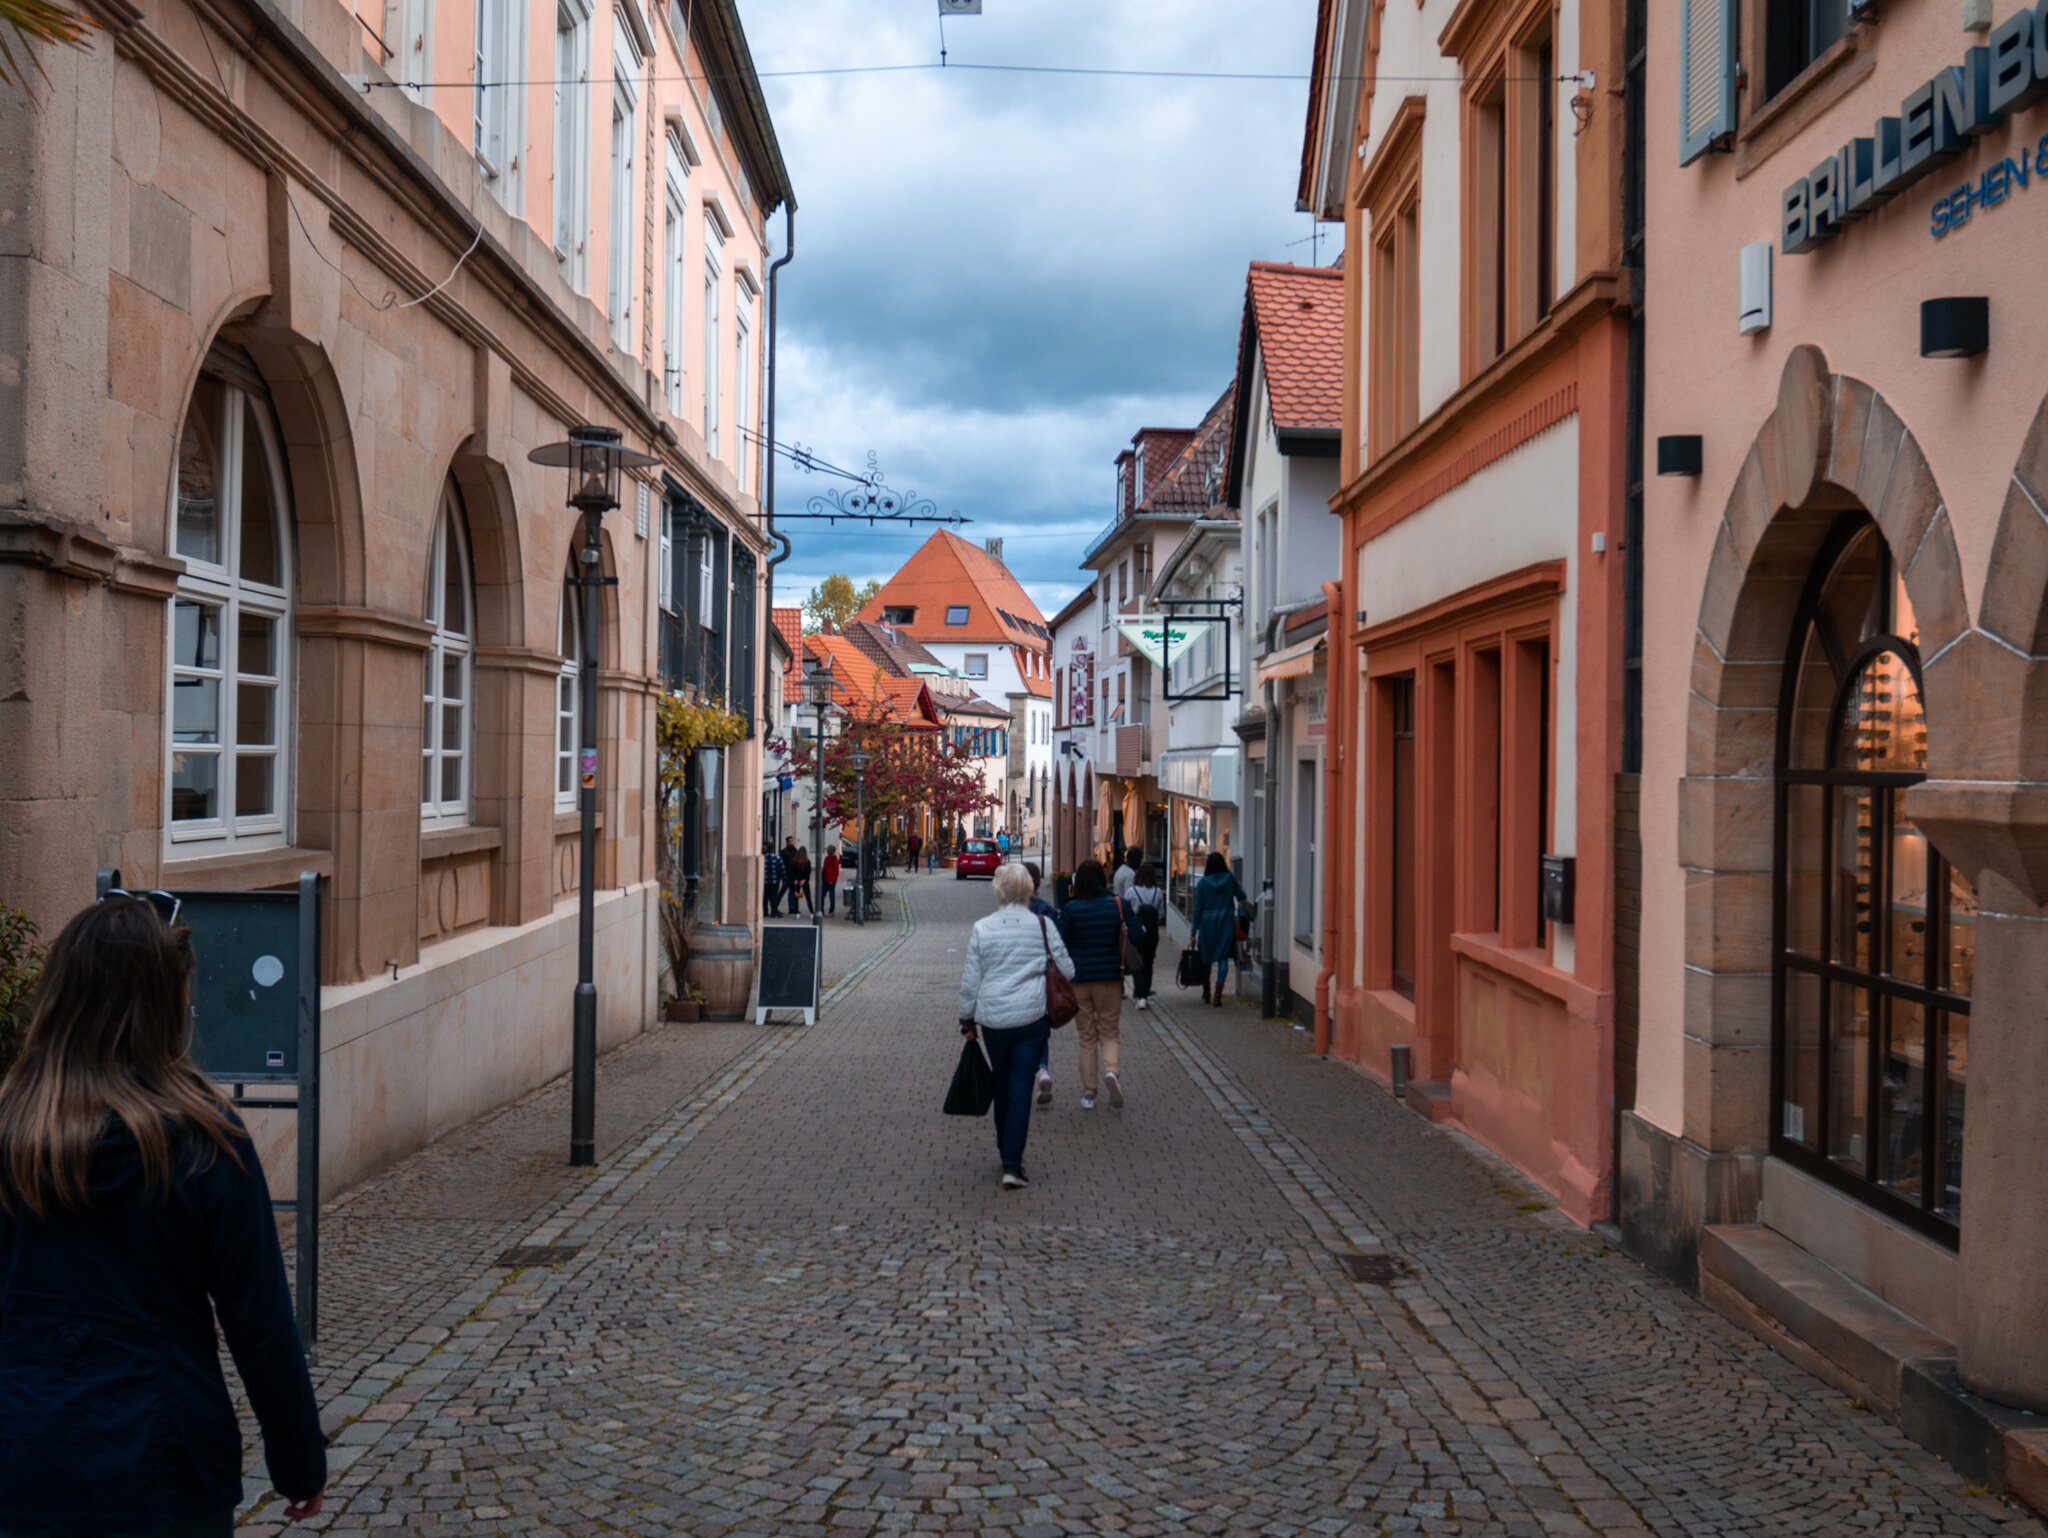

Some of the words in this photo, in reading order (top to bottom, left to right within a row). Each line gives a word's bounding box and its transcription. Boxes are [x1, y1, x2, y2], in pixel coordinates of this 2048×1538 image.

[1782, 47, 1978, 255] BRILLEN
[1931, 147, 2028, 237] SEHEN
[1072, 636, 1088, 723] ASIAN
